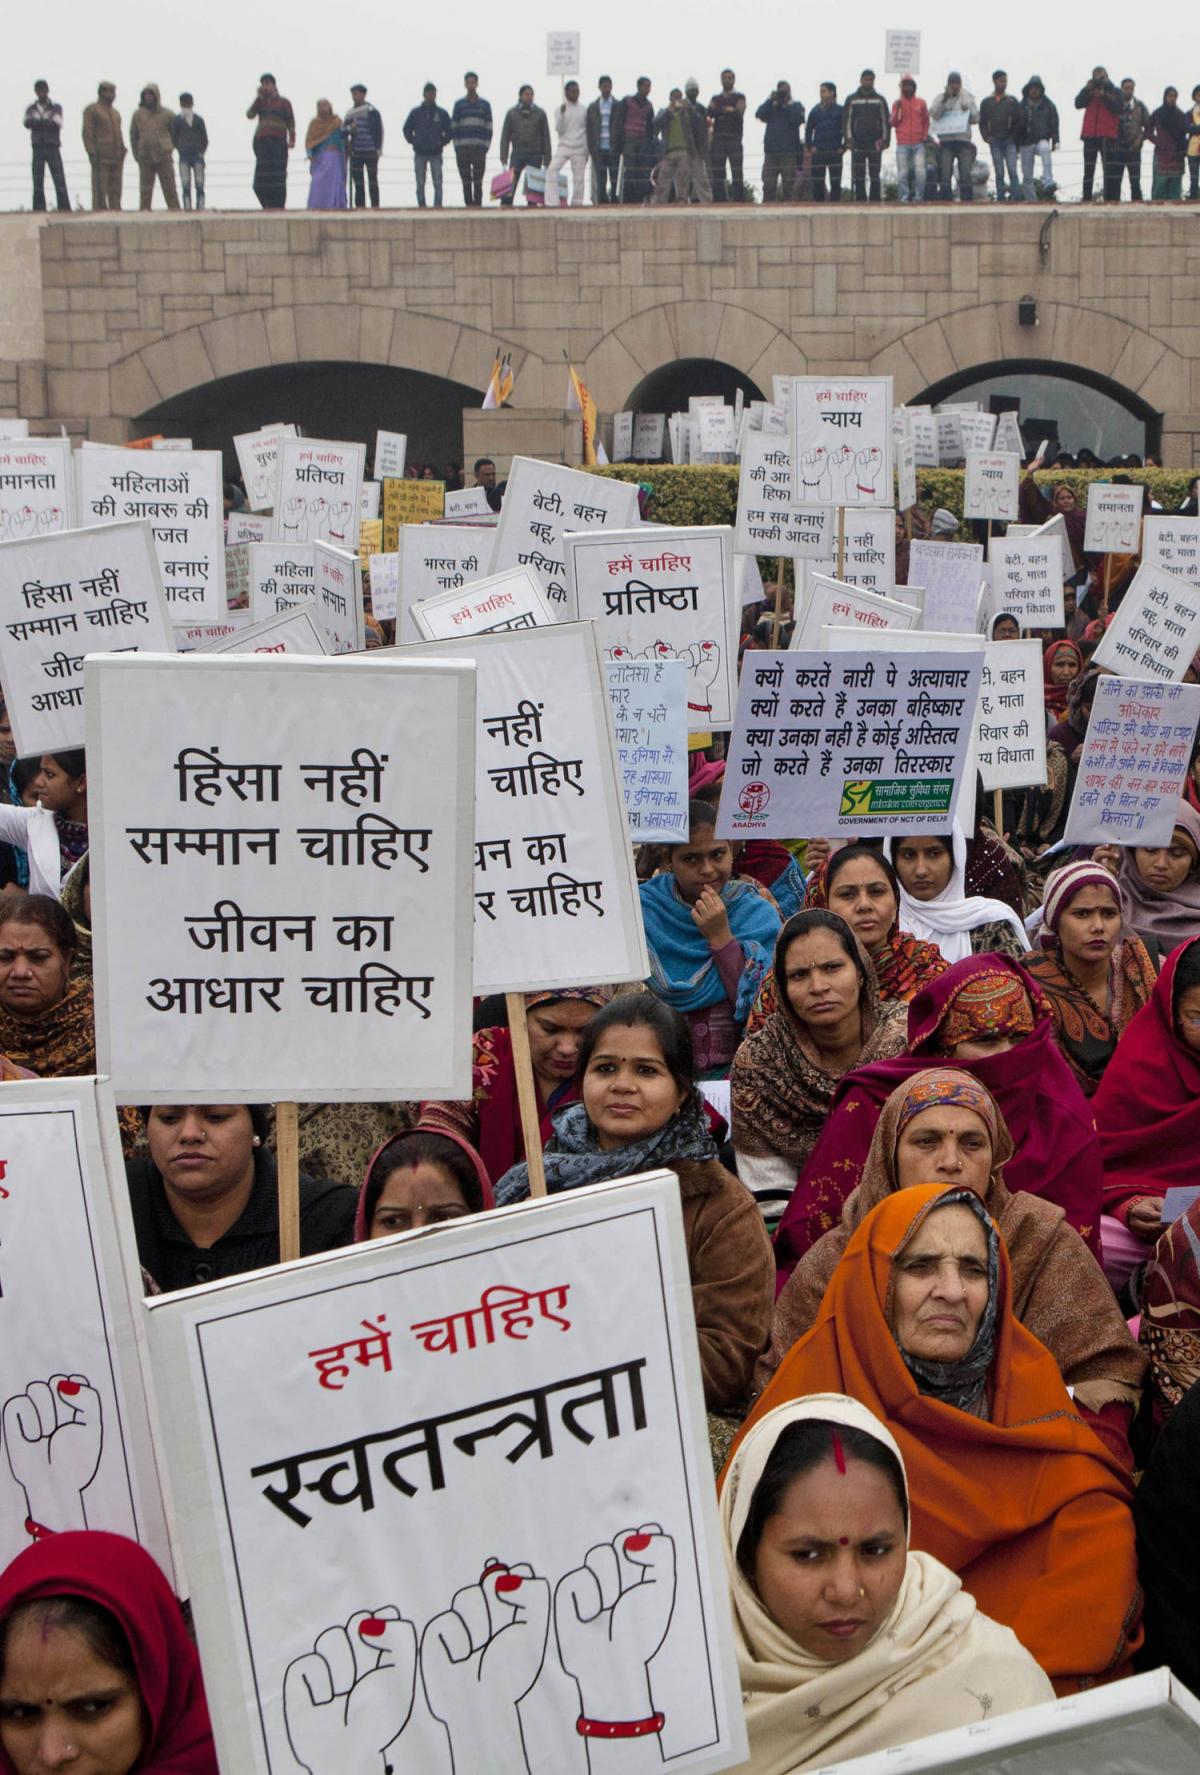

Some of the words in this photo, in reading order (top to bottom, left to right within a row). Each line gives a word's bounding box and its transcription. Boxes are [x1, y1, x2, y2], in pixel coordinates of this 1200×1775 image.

[816, 390, 832, 402] हमें
[835, 390, 868, 403] चाहिए
[821, 412, 863, 428] न्याय
[316, 453, 343, 465] चाहिए
[110, 471, 189, 493] महिलाओं
[296, 464, 344, 485] प्रतिष्ठा
[91, 495, 115, 517] की
[124, 501, 177, 518] आबरू
[185, 497, 208, 519] की
[573, 502, 607, 524] बहन
[1097, 503, 1135, 513] समानता
[747, 510, 764, 523] हम
[770, 510, 788, 524] सब
[794, 511, 825, 529] बनाएं
[748, 526, 781, 542] पक्की
[787, 530, 820, 544] आदत
[853, 532, 874, 548] नहीं
[1180, 533, 1199, 543] बहन
[424, 557, 456, 571] भारत
[461, 555, 478, 571] की
[853, 549, 885, 566] चाहिए
[1028, 554, 1048, 565] बहन
[1178, 548, 1197, 558] माता
[164, 555, 209, 580] बनाएं
[608, 553, 632, 575] हमें
[640, 553, 692, 574] चाहिए
[438, 573, 464, 589] नारी
[1027, 570, 1047, 580] माता
[21, 580, 72, 609] हिंसा
[79, 568, 120, 597] नहीं
[261, 579, 277, 595] की
[1005, 589, 1036, 600] परिवार
[1038, 588, 1051, 600] की
[603, 580, 699, 616] प्रतिष्ठा
[5, 613, 78, 641] सम्मान
[84, 598, 149, 627] चाहिए
[451, 606, 472, 625] हमें
[475, 593, 515, 613] चाहिए
[832, 600, 850, 617] हमें
[854, 608, 888, 628] चाहिए
[1173, 601, 1197, 622] बहन
[1163, 619, 1187, 638] माता
[1128, 626, 1163, 653] परिवार
[1164, 643, 1180, 661] की
[1115, 641, 1140, 663] भाग्य
[1140, 650, 1176, 680] विधाता
[755, 661, 784, 689] क्यों
[795, 661, 832, 689] करतें
[842, 662, 875, 689] नारी
[886, 662, 898, 689] पे
[907, 669, 970, 689] अत्याचार
[1001, 668, 1026, 684] बहन
[750, 691, 780, 718] क्यों
[790, 691, 826, 718] करते
[835, 691, 848, 719] हैं
[856, 697, 897, 718] उनका
[906, 691, 965, 718] बहिष्कार
[999, 692, 1025, 708] माता
[483, 700, 544, 748] नहीं
[1014, 719, 1029, 738] की
[746, 727, 775, 749] क्या
[778, 728, 821, 748] उनका
[825, 720, 852, 749] नहीं
[857, 721, 869, 749] है
[872, 719, 903, 751] कोई
[904, 720, 961, 747] अस्तित्व
[741, 750, 763, 777] जो
[774, 750, 810, 776] करते
[820, 750, 833, 777] हैं
[843, 756, 884, 776] उनका
[894, 749, 955, 774] तिरस्कार
[997, 747, 1034, 764] विधाता
[174, 746, 283, 807] हिंसा
[300, 748, 390, 808] नहीं
[487, 751, 585, 797] चाहिए
[874, 781, 908, 797] सामाजिक
[932, 783, 951, 796] संगम
[732, 822, 767, 830] ARADHYA
[838, 817, 888, 826] GOVERNMENT
[889, 817, 899, 825] OF
[900, 816, 912, 825] NCT
[913, 816, 926, 825] OF
[927, 815, 948, 824] DELHI
[126, 826, 280, 866] सम्मान
[297, 812, 433, 874] चाहिए
[522, 834, 567, 866] का
[507, 872, 605, 918] चाहिए
[184, 899, 316, 954] जीवन
[333, 915, 395, 954] का
[145, 976, 285, 1016] आधार
[302, 962, 434, 1020] चाहिए
[309, 1314, 394, 1391] हमें
[411, 1283, 572, 1358] चाहिए
[250, 1357, 648, 1529] स्वतन्त्रता
